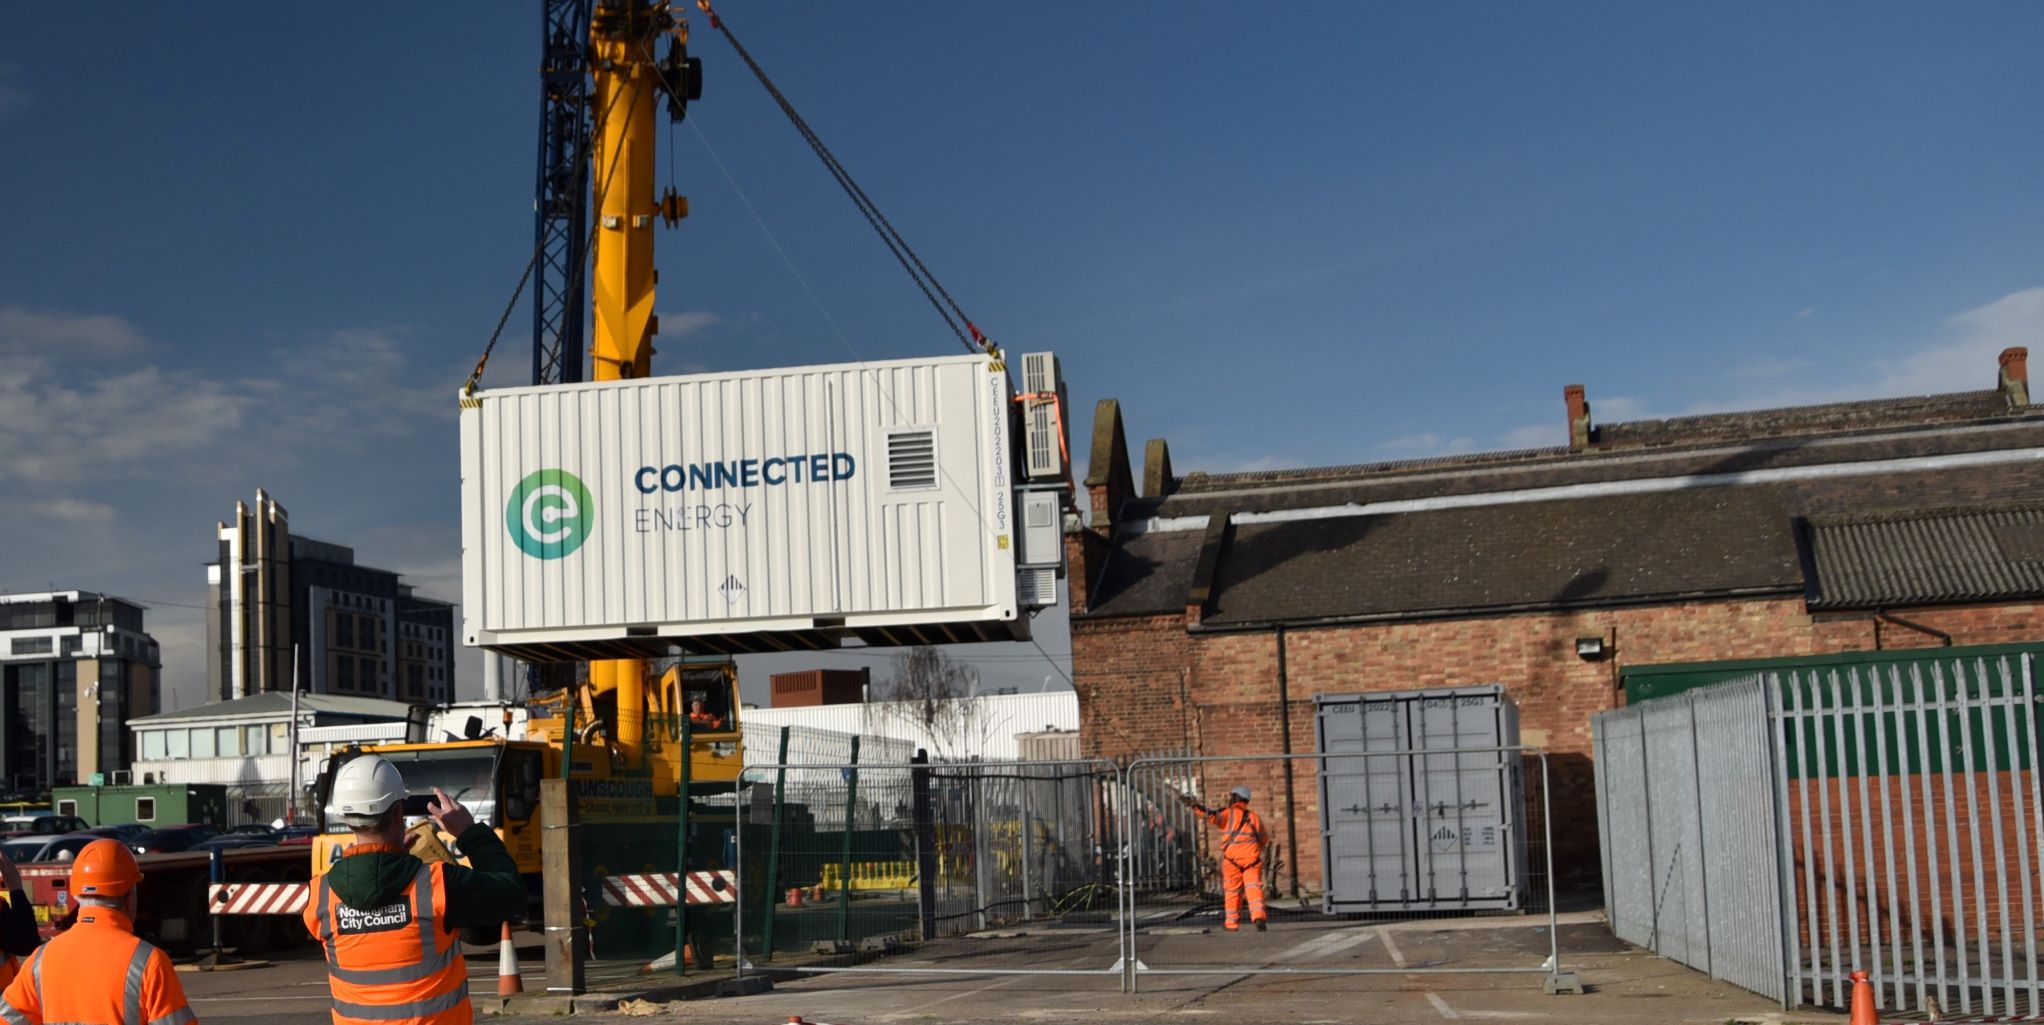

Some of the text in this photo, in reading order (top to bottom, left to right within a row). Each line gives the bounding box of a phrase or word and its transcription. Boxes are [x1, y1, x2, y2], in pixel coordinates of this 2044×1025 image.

[635, 452, 855, 494] CONNECTED
[635, 503, 753, 533] ENERGY
[341, 911, 406, 930] City Council
